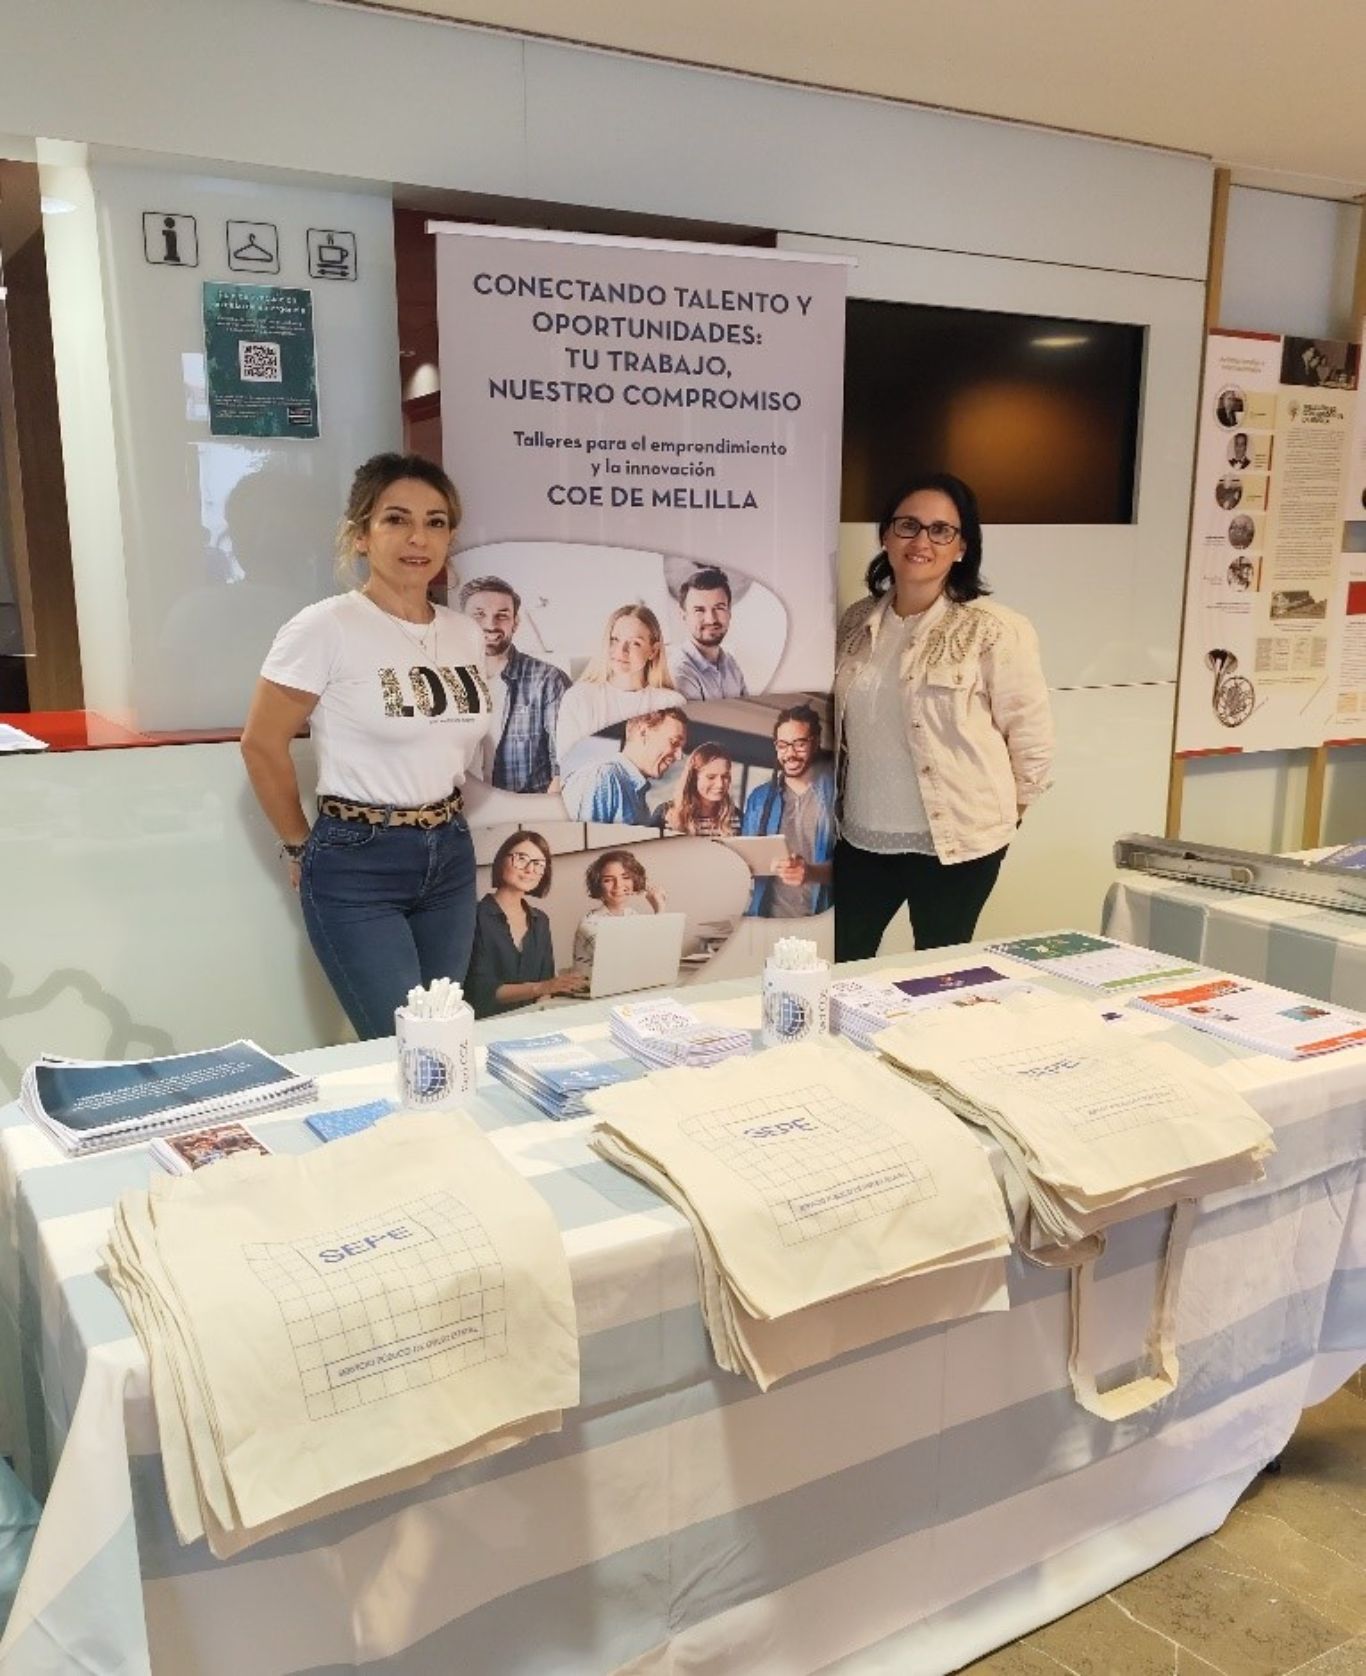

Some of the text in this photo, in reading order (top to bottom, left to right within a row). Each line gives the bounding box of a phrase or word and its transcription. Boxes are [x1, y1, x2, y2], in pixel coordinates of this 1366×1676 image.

[473, 273, 813, 315] CONECTANDO TALENTO Y
[532, 311, 763, 345] OPORTUNIDADES:
[565, 347, 733, 379] TU TRABAJO,
[489, 377, 802, 411] NUESTRO COMPROMISO
[513, 431, 787, 456] Talleres para el emprendimiento
[591, 458, 716, 477] y la innovación
[547, 484, 758, 509] COE DE MELILLA
